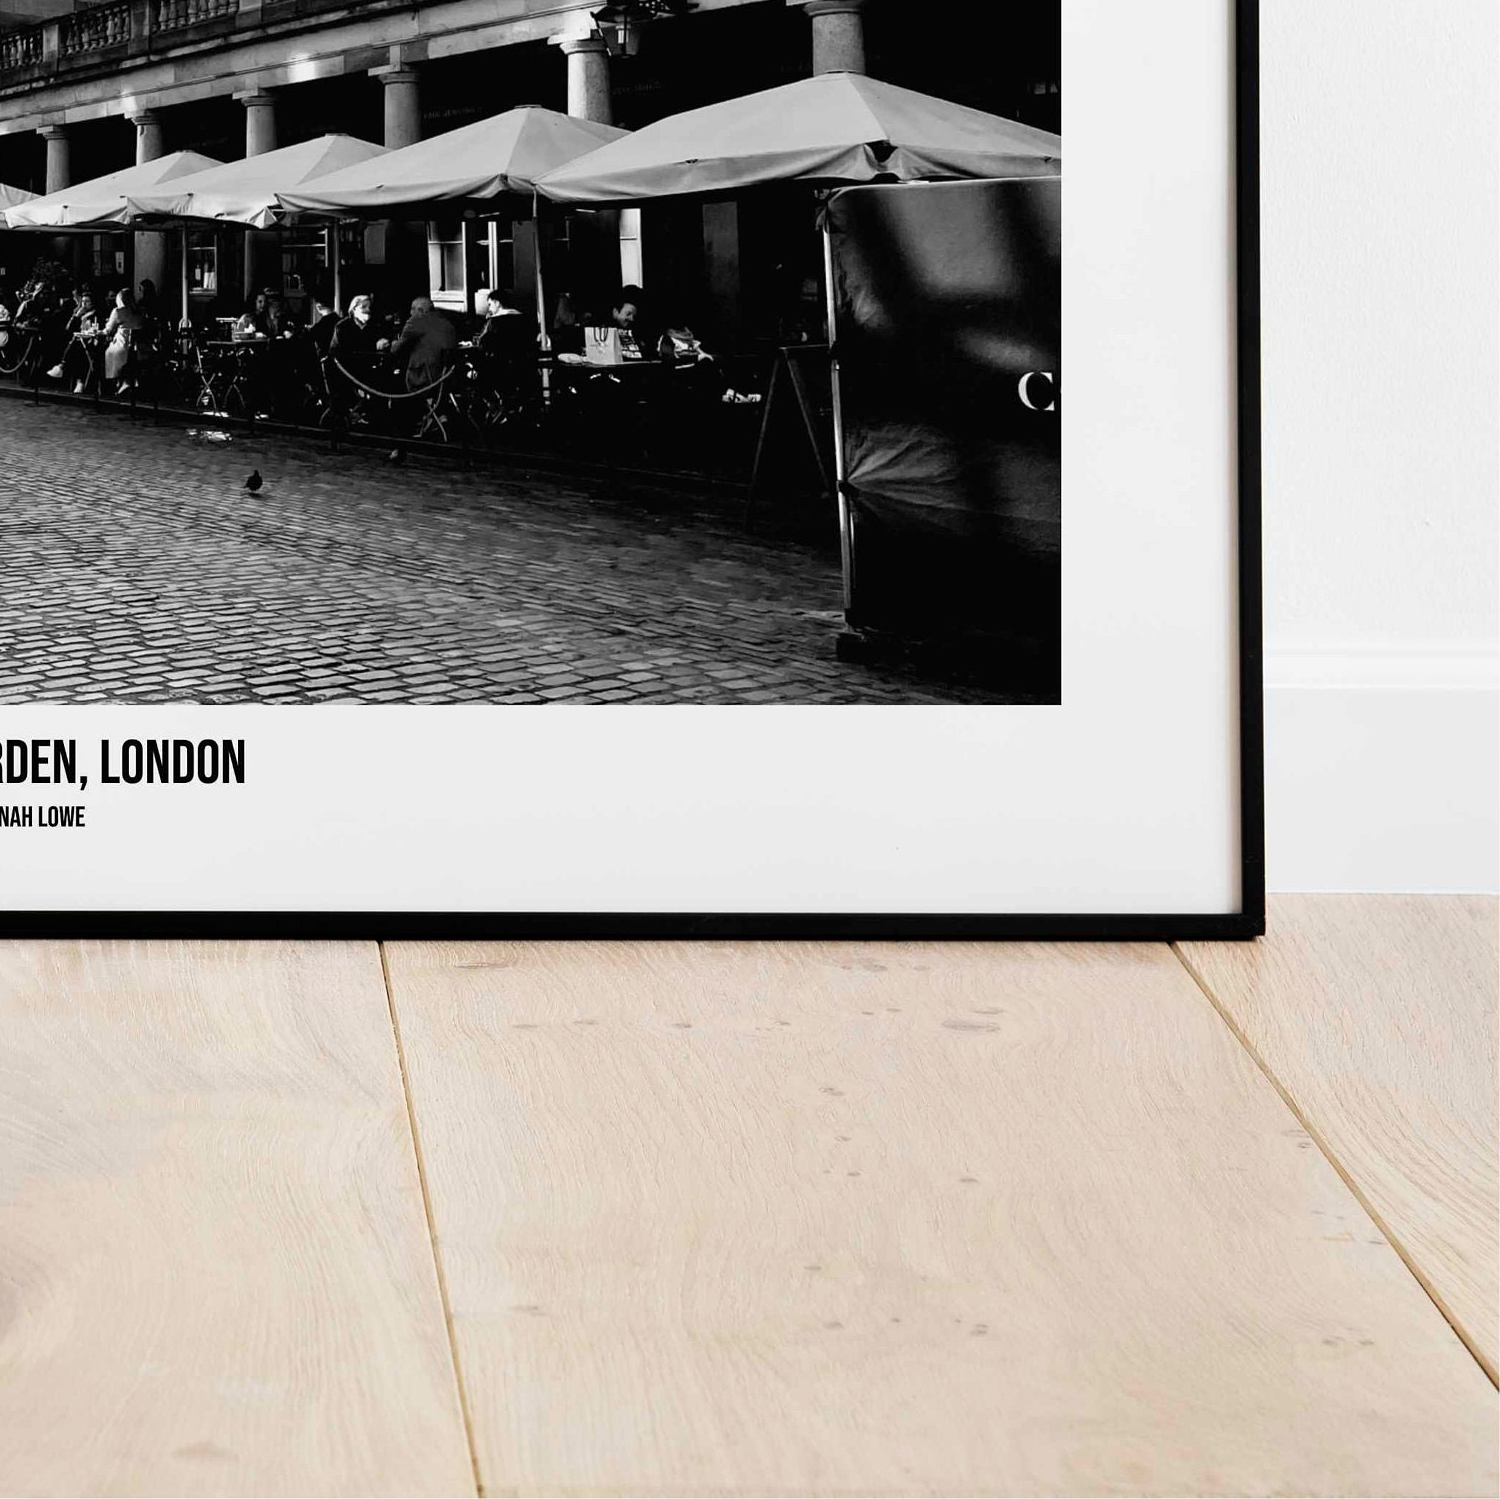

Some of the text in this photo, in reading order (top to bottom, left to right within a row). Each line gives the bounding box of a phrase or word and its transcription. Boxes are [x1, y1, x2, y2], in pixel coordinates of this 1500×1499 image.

[1018, 371, 1061, 411] C
[101, 738, 245, 785] LONDON
[38, 805, 86, 828] LOWE
